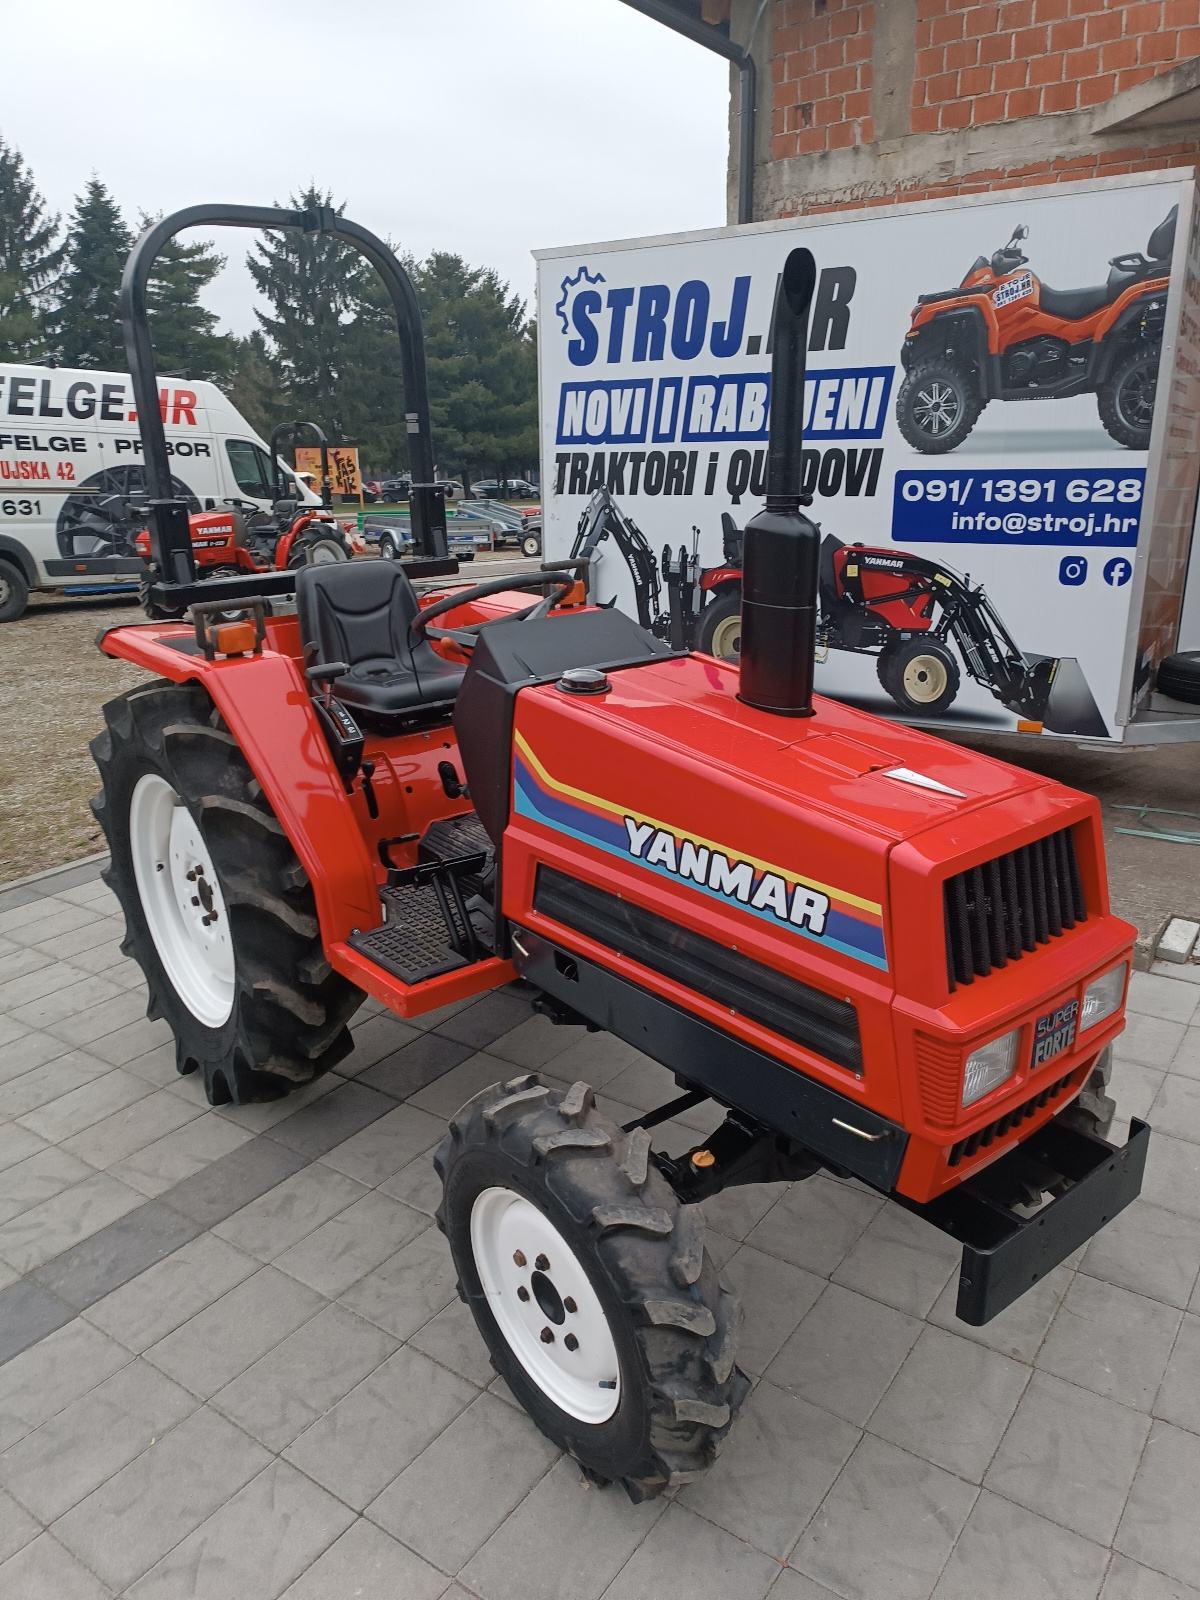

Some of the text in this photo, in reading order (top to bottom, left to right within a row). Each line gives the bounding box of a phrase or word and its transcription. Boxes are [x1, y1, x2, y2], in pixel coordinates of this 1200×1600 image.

[0, 376, 197, 425] ELGE.R
[561, 377, 886, 437] NOVI I RABJENI
[114, 439, 211, 457] PRBOR
[56, 461, 76, 481] 42
[555, 447, 884, 505] TRAKTORI i QUDOVI
[2, 499, 42, 516] 631
[902, 478, 1142, 506] 091/ 1391 628
[951, 511, 1138, 537] info@stroj.hr
[628, 553, 643, 586] YANMAR
[864, 556, 905, 569] YANMAR
[624, 815, 831, 936] YANMAR
[1037, 1000, 1079, 1038] SUPER
[1034, 1021, 1077, 1068] FORTE
